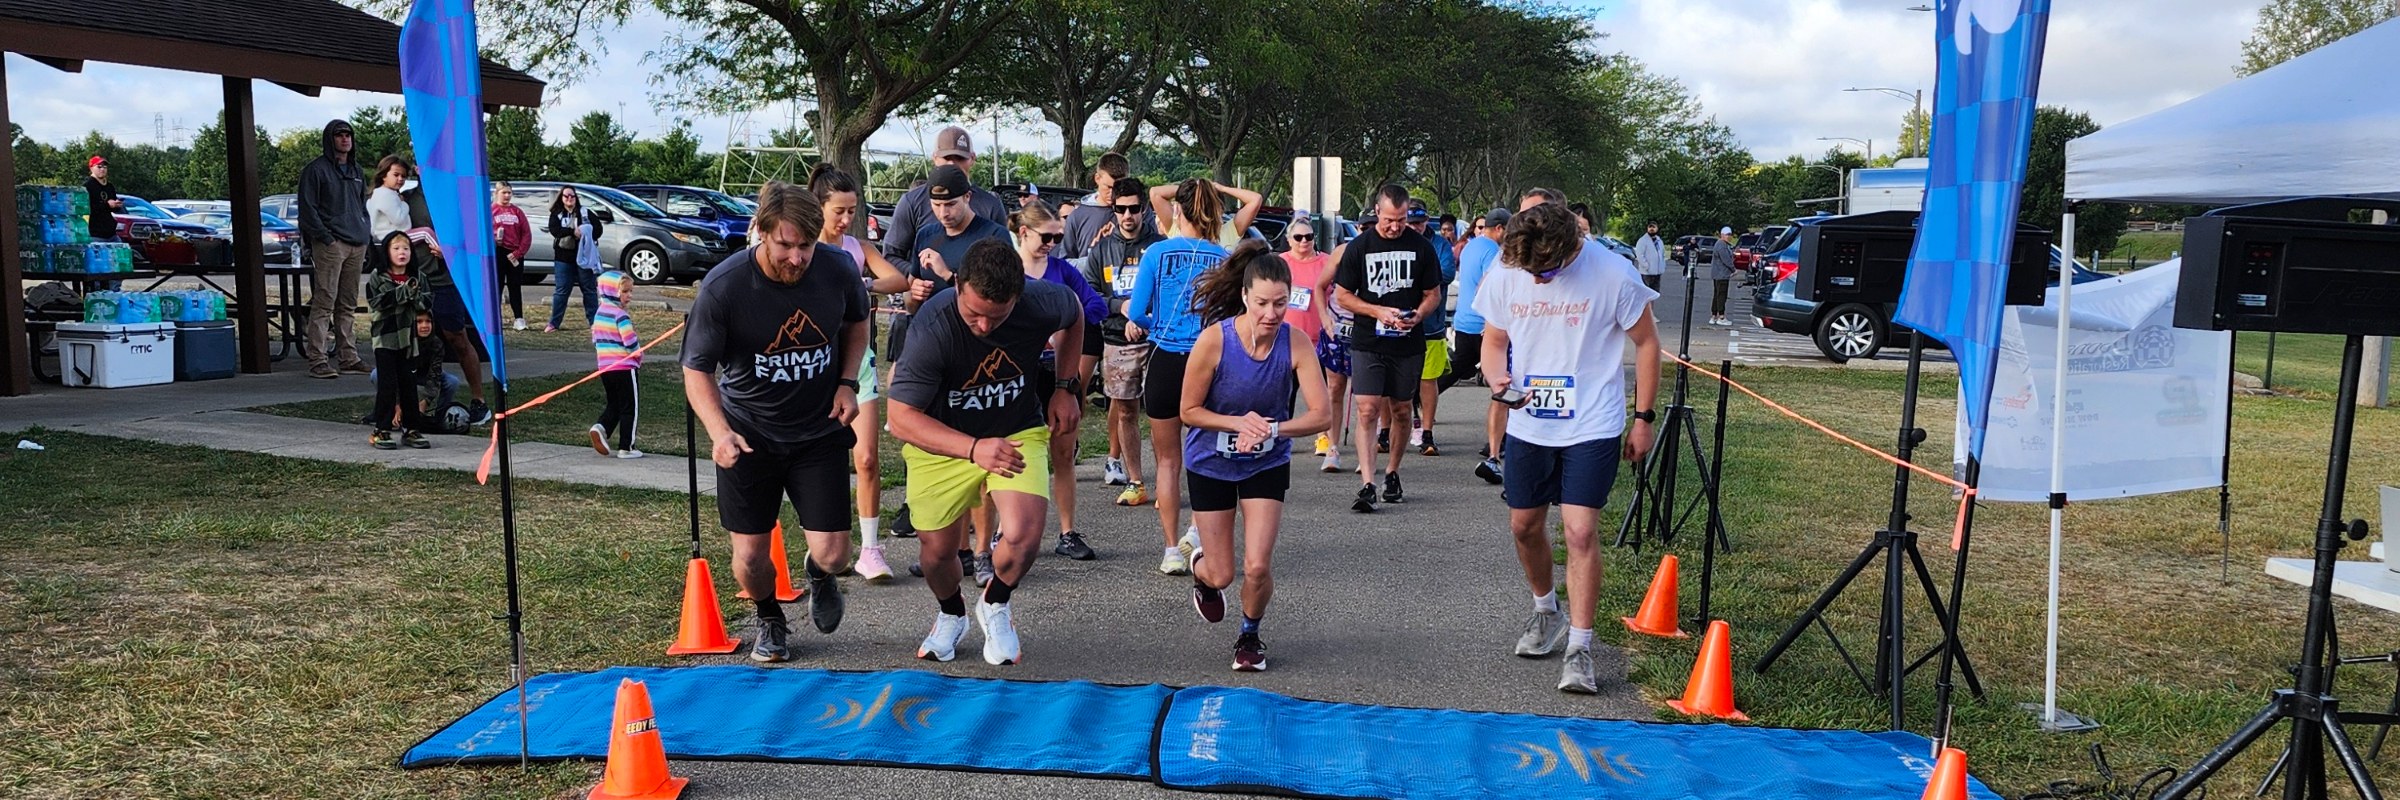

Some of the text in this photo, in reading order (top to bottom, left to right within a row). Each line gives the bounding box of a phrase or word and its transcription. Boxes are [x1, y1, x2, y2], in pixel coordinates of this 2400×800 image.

[1119, 275, 1134, 289] 57
[1292, 292, 1306, 305] 76
[1532, 297, 1590, 318] Trained
[1340, 325, 1353, 337] 40
[754, 344, 832, 367] PRIMAL
[754, 353, 831, 383] FAITH
[1531, 388, 1566, 409] 575
[1227, 434, 1264, 452] 55
[626, 720, 647, 735] EEDY
